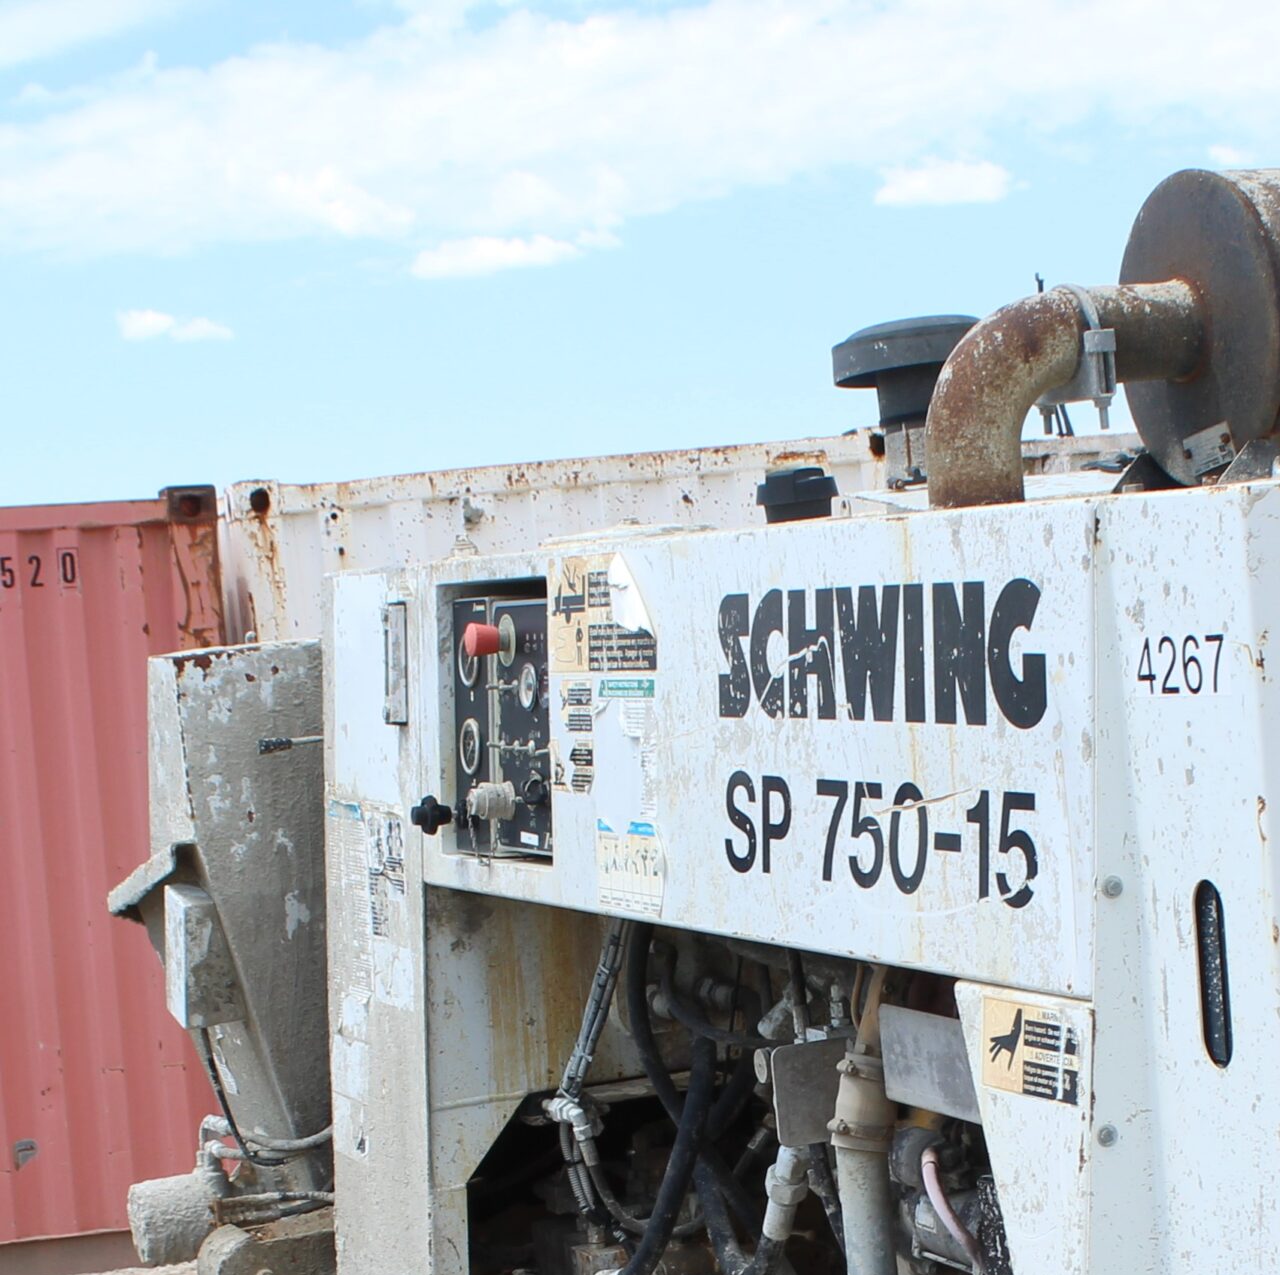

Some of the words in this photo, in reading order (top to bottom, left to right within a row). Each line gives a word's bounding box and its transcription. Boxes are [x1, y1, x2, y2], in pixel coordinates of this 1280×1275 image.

[718, 578, 1047, 729] SCHWING
[1136, 634, 1225, 695] 4267
[724, 770, 792, 874] SP
[816, 775, 1039, 909] 750-15
[1035, 1051, 1074, 1067] ADVERTECIA
